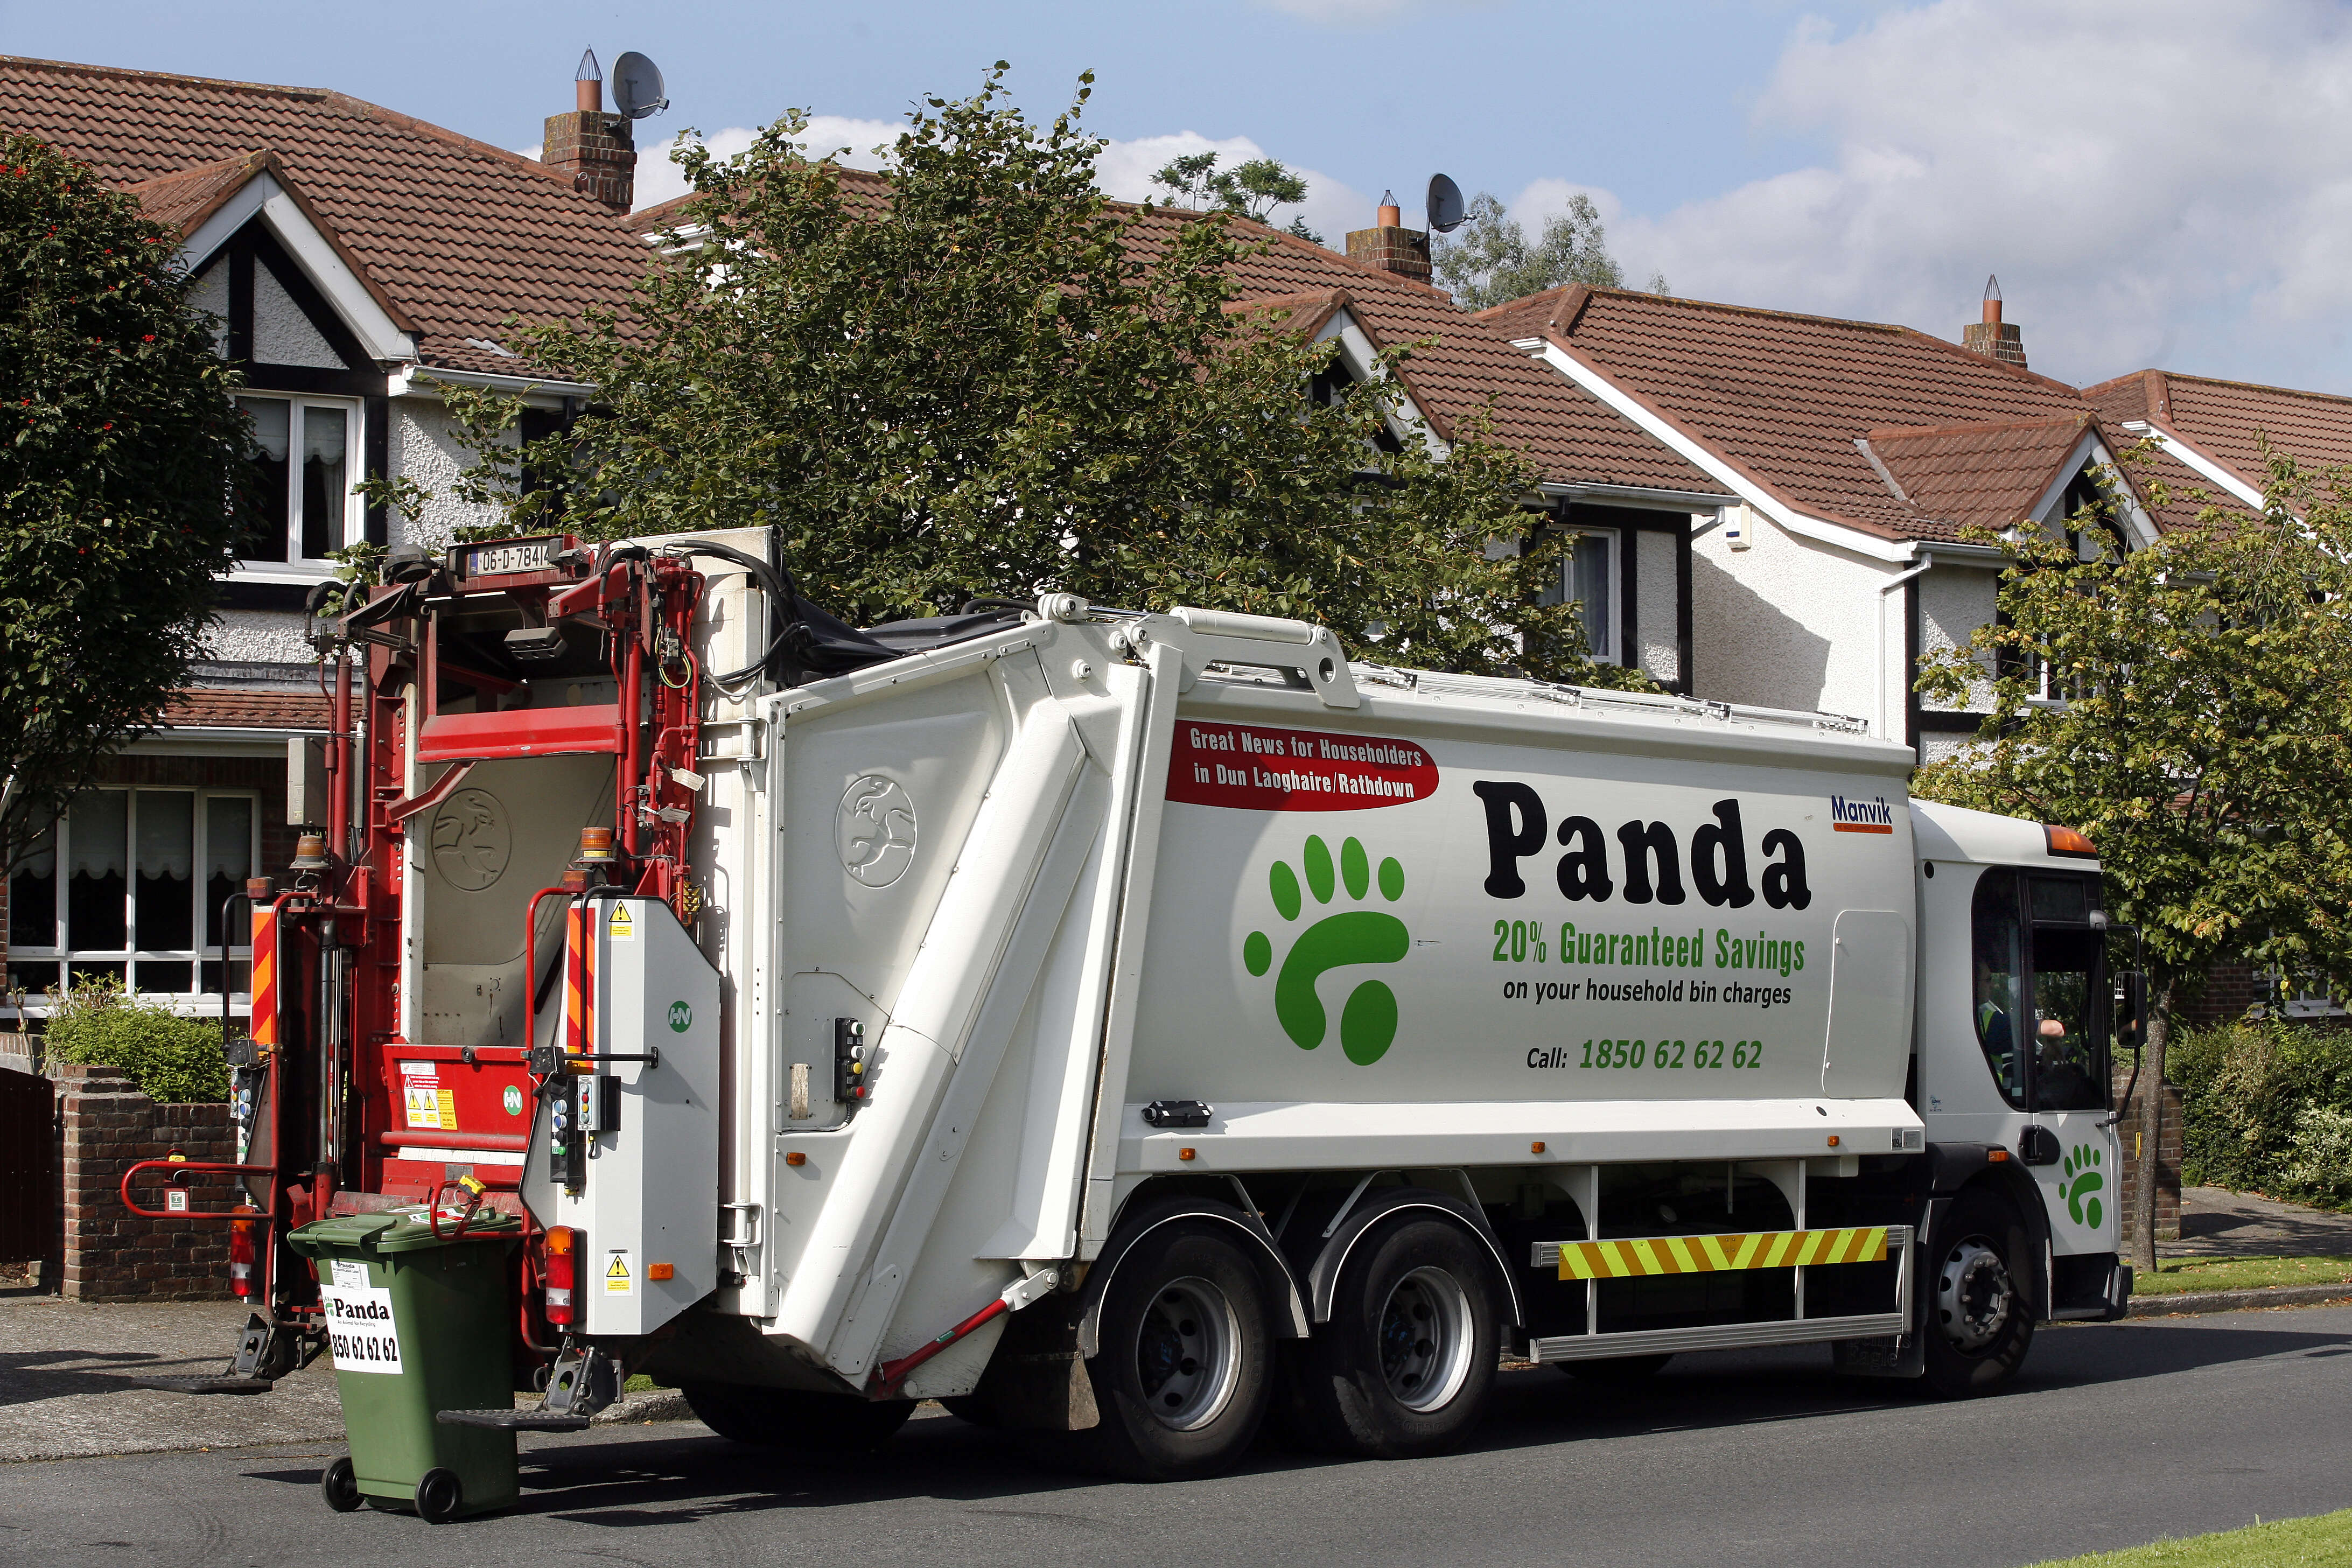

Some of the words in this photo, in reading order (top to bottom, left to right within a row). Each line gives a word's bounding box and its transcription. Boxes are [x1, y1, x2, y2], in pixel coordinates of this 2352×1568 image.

[1190, 727, 1235, 751] Great
[1241, 732, 1285, 755] News
[1290, 737, 1313, 758] for
[1319, 739, 1422, 767] Householders
[1194, 762, 1210, 783] in
[1216, 764, 1247, 786] Dun
[1253, 766, 1415, 798] Laoghaire/Rathdown
[1831, 795, 1892, 824] Manvik
[1472, 780, 1812, 911] Panda
[1493, 920, 1546, 963] 20%
[1560, 922, 1704, 968] Guaranteed
[1716, 928, 1805, 977] Savings
[1503, 981, 1528, 999] on
[1535, 982, 1580, 1005] your
[1586, 977, 1684, 1003] household
[1689, 980, 1717, 1003] bin
[1723, 981, 1791, 1010] charges
[1526, 1047, 1567, 1069] Call:
[1579, 1039, 1646, 1069] 1850
[1654, 1040, 1685, 1069] 62
[1694, 1040, 1724, 1069] 62
[1732, 1040, 1762, 1068] 62
[333, 1298, 390, 1320] Panda
[331, 1334, 350, 1359] 850
[352, 1335, 365, 1360] 62
[367, 1336, 381, 1361] 62
[383, 1337, 398, 1362] 62
